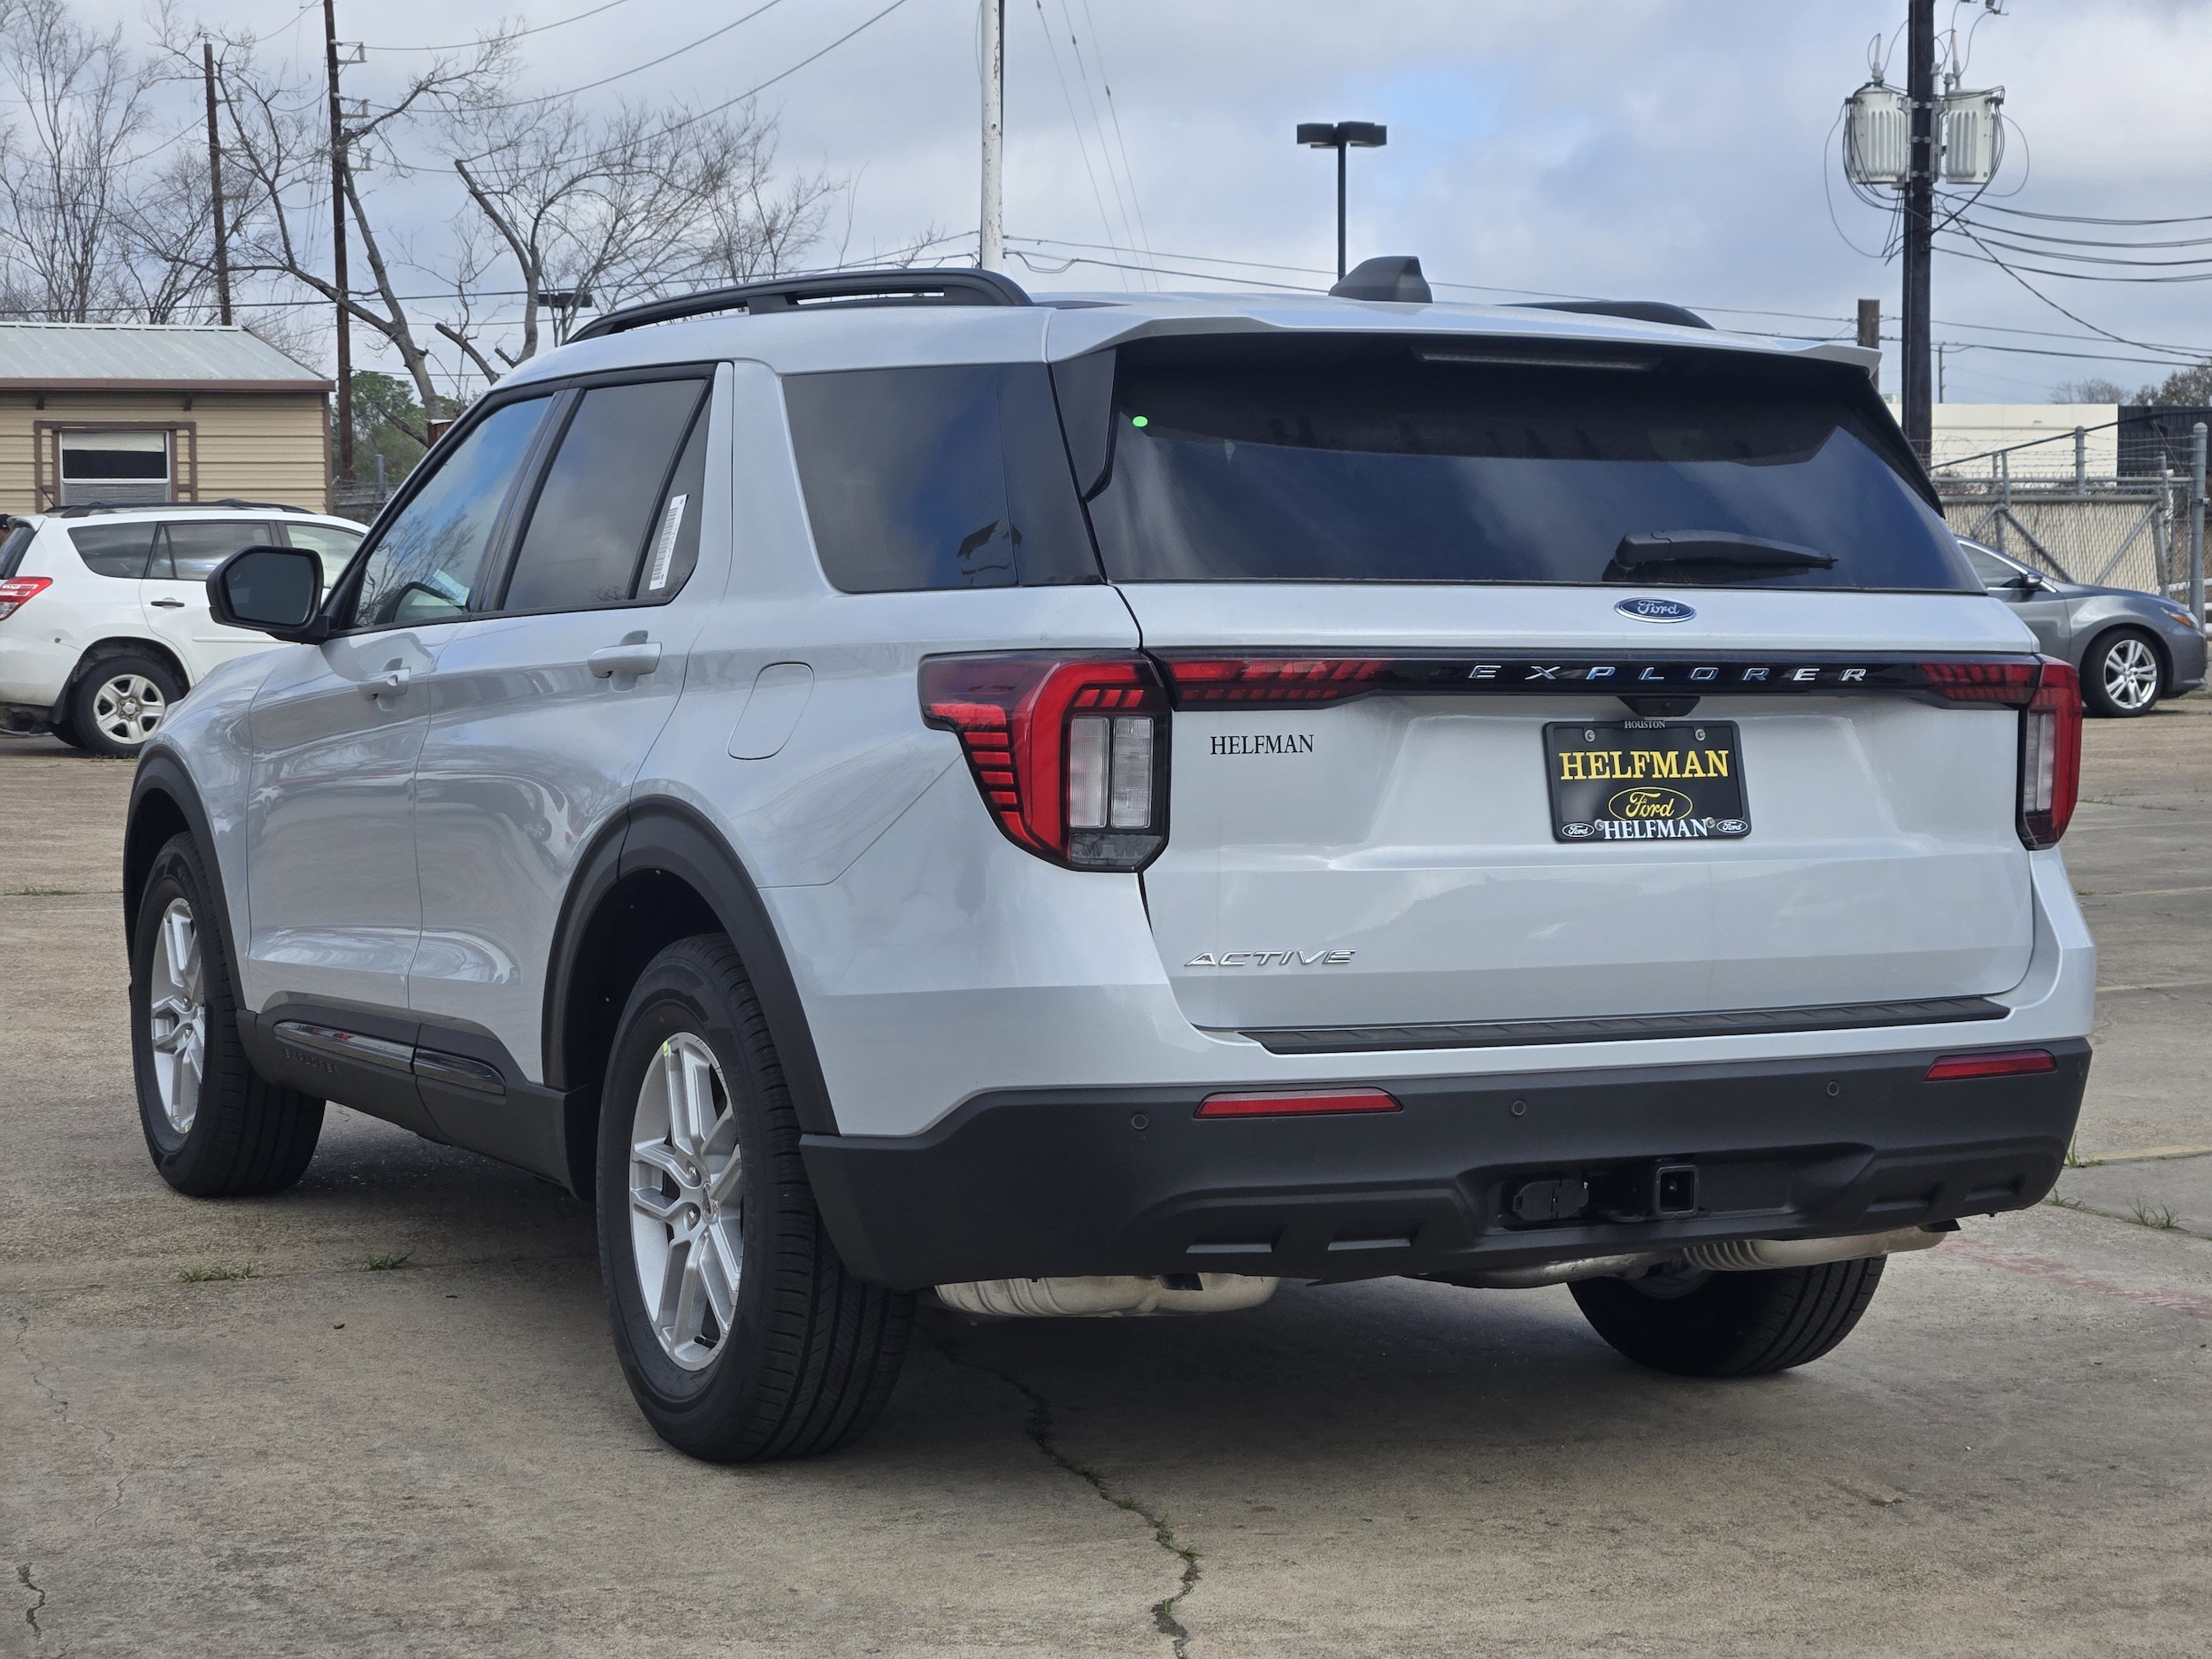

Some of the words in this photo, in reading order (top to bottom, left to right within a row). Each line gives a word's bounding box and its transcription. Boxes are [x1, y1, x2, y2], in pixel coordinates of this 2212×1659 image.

[1468, 664, 1867, 682] EXPLORER
[1624, 720, 1666, 729] HOUSTON
[1210, 733, 1315, 755] HELFMAN
[1558, 749, 1729, 780] HELFMAN
[1625, 791, 1675, 818] Ford
[1602, 818, 1709, 840] HELFMAN
[1184, 949, 1356, 967] ACTIVE
